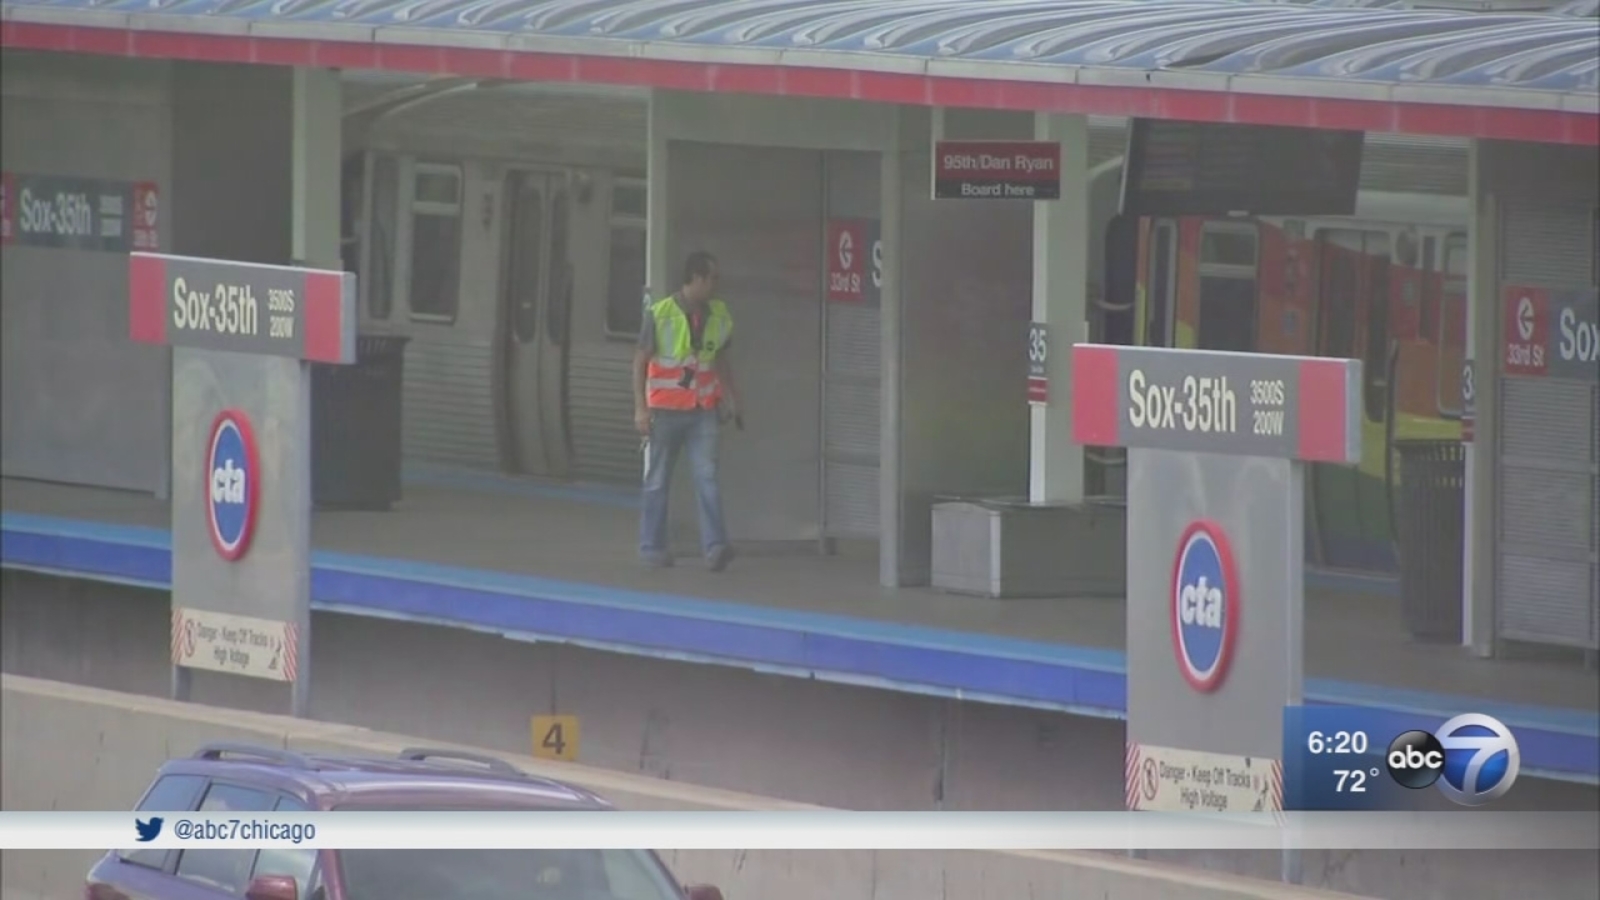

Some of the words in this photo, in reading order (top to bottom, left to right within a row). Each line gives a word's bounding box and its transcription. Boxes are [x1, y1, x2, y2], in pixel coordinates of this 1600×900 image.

[1014, 155, 1054, 174] Ryan
[960, 183, 1001, 196] Board
[1004, 184, 1036, 196] here
[20, 187, 91, 235] Sox-35th
[173, 276, 257, 336] Sox-35th
[1029, 327, 1047, 363] 35
[1507, 343, 1531, 366] 33rd
[1532, 344, 1546, 368] St
[1128, 368, 1236, 433] Sox-35th
[1250, 379, 1285, 406] 3500S
[1252, 410, 1284, 436] 200W
[212, 458, 246, 503] cta
[1179, 575, 1223, 629] cta
[542, 722, 566, 756] 4
[1159, 760, 1186, 784] Danger
[1192, 765, 1211, 787] Keep
[1213, 766, 1225, 786] Off
[1226, 768, 1251, 789] Tracks
[1180, 785, 1199, 810] High
[1200, 789, 1228, 812] Voltage
